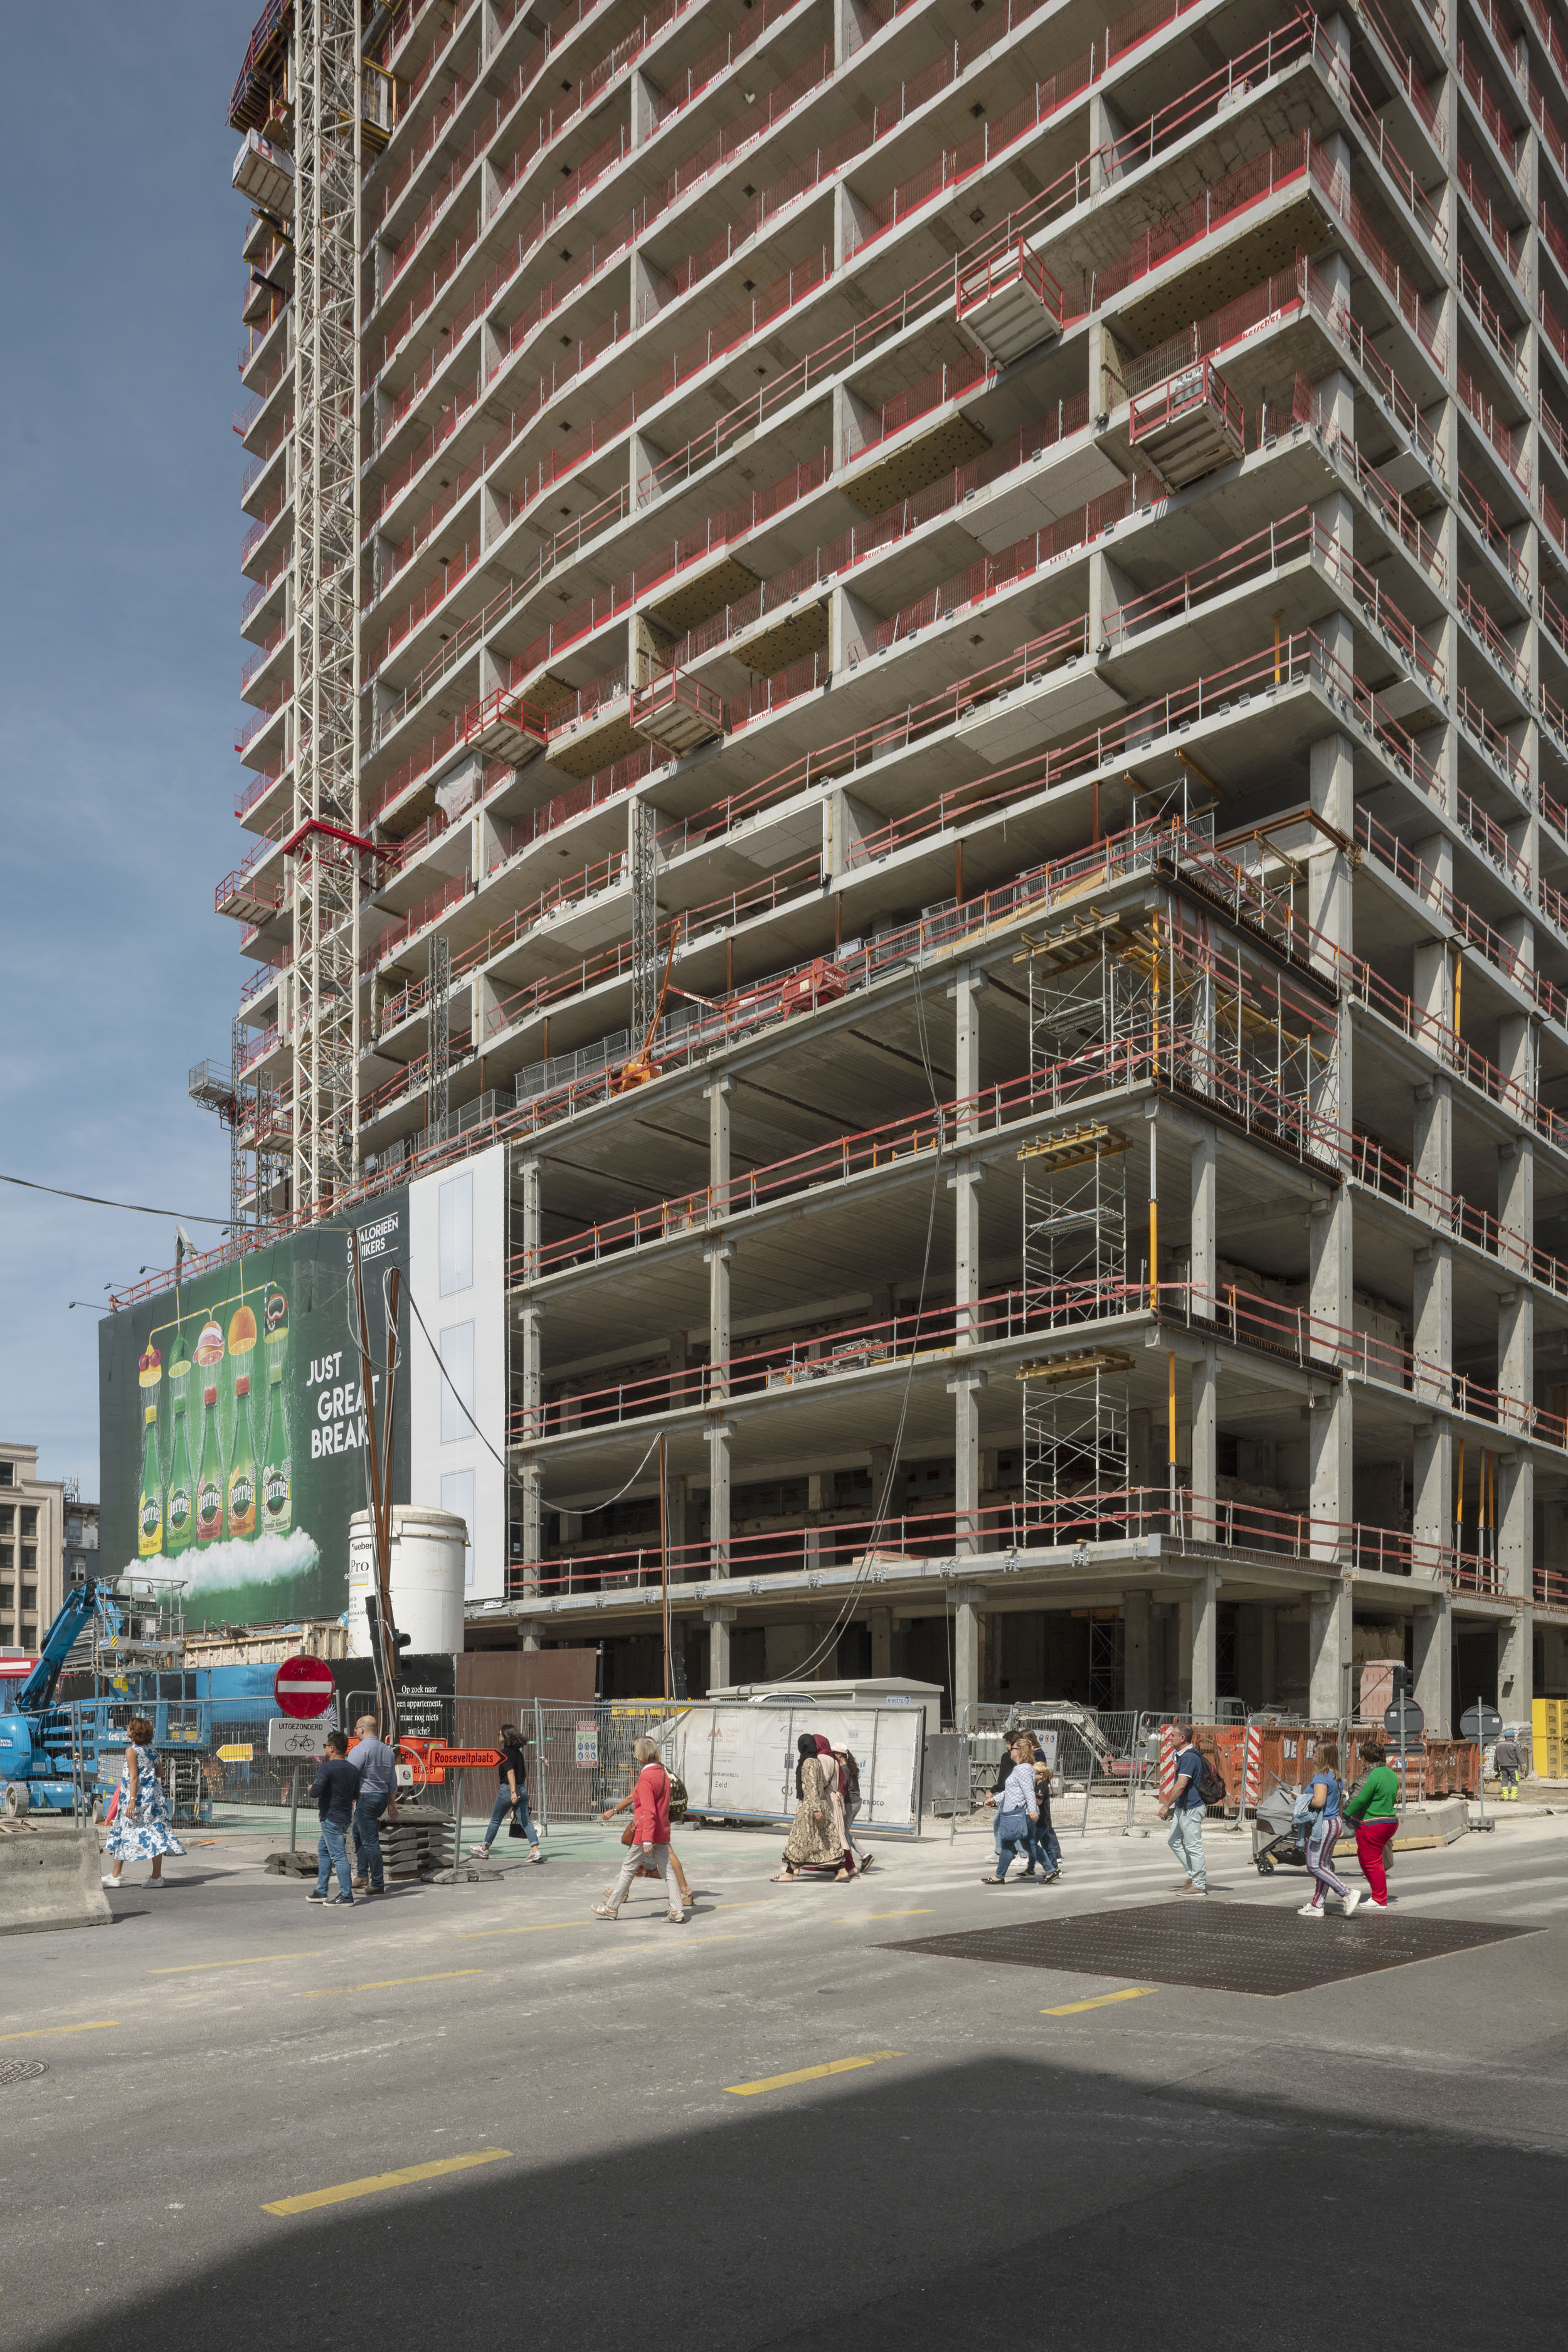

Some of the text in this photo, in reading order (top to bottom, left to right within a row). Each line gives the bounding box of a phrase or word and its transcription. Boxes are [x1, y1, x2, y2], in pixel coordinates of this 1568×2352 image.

[360, 1217, 398, 1242] ALORIEËN
[306, 1351, 342, 1387] JUST
[311, 1414, 369, 1459] BREAK
[401, 1685, 410, 1694] Op
[411, 1685, 423, 1693] zoek
[407, 1700, 443, 1709] appartement,
[415, 1715, 425, 1723] nog
[426, 1713, 439, 1721] niets
[408, 1727, 430, 1735] inicht?
[435, 1752, 494, 1765] Rooseveltplaats
